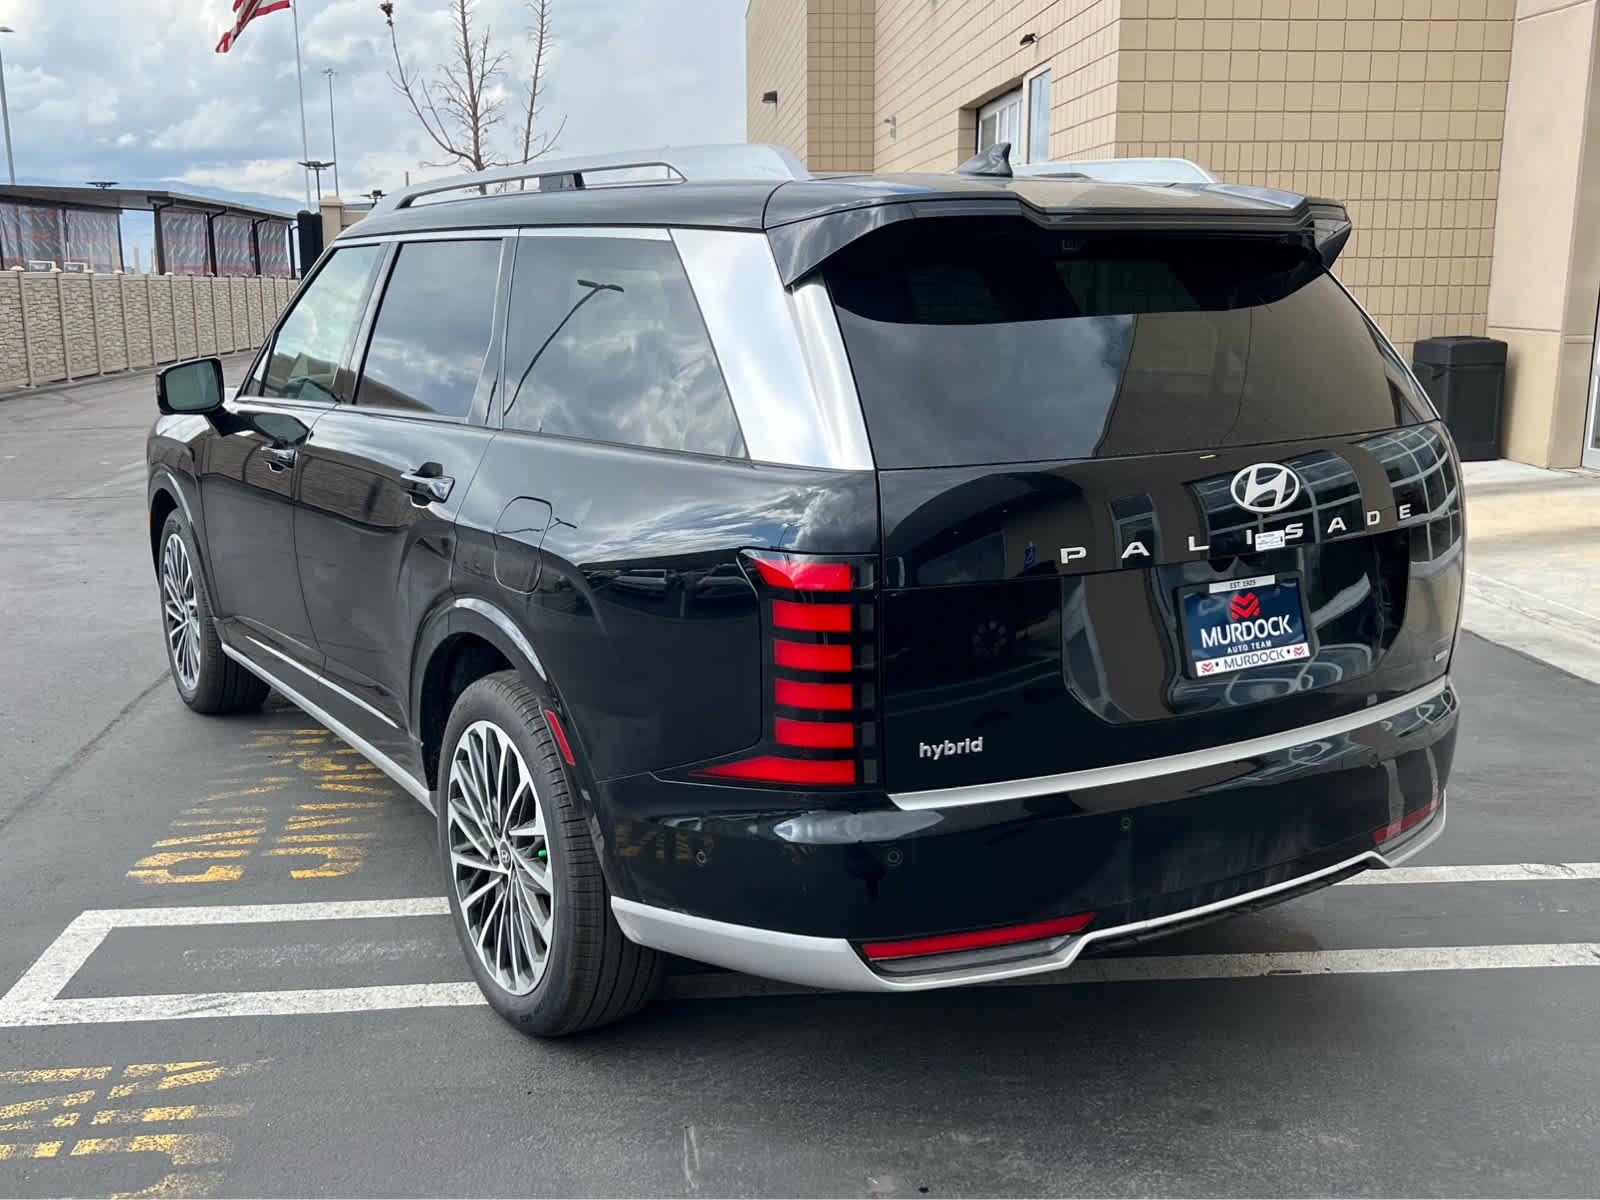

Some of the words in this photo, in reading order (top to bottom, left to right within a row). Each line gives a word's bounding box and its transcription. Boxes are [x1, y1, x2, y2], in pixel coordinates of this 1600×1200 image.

[1060, 504, 1412, 564] PALISADE
[1200, 614, 1293, 649] MURDOCK
[1223, 649, 1286, 670] MURDOCK
[1227, 644, 1249, 654] AUTO
[1251, 640, 1272, 650] TEAM
[919, 736, 984, 761] hybrid
